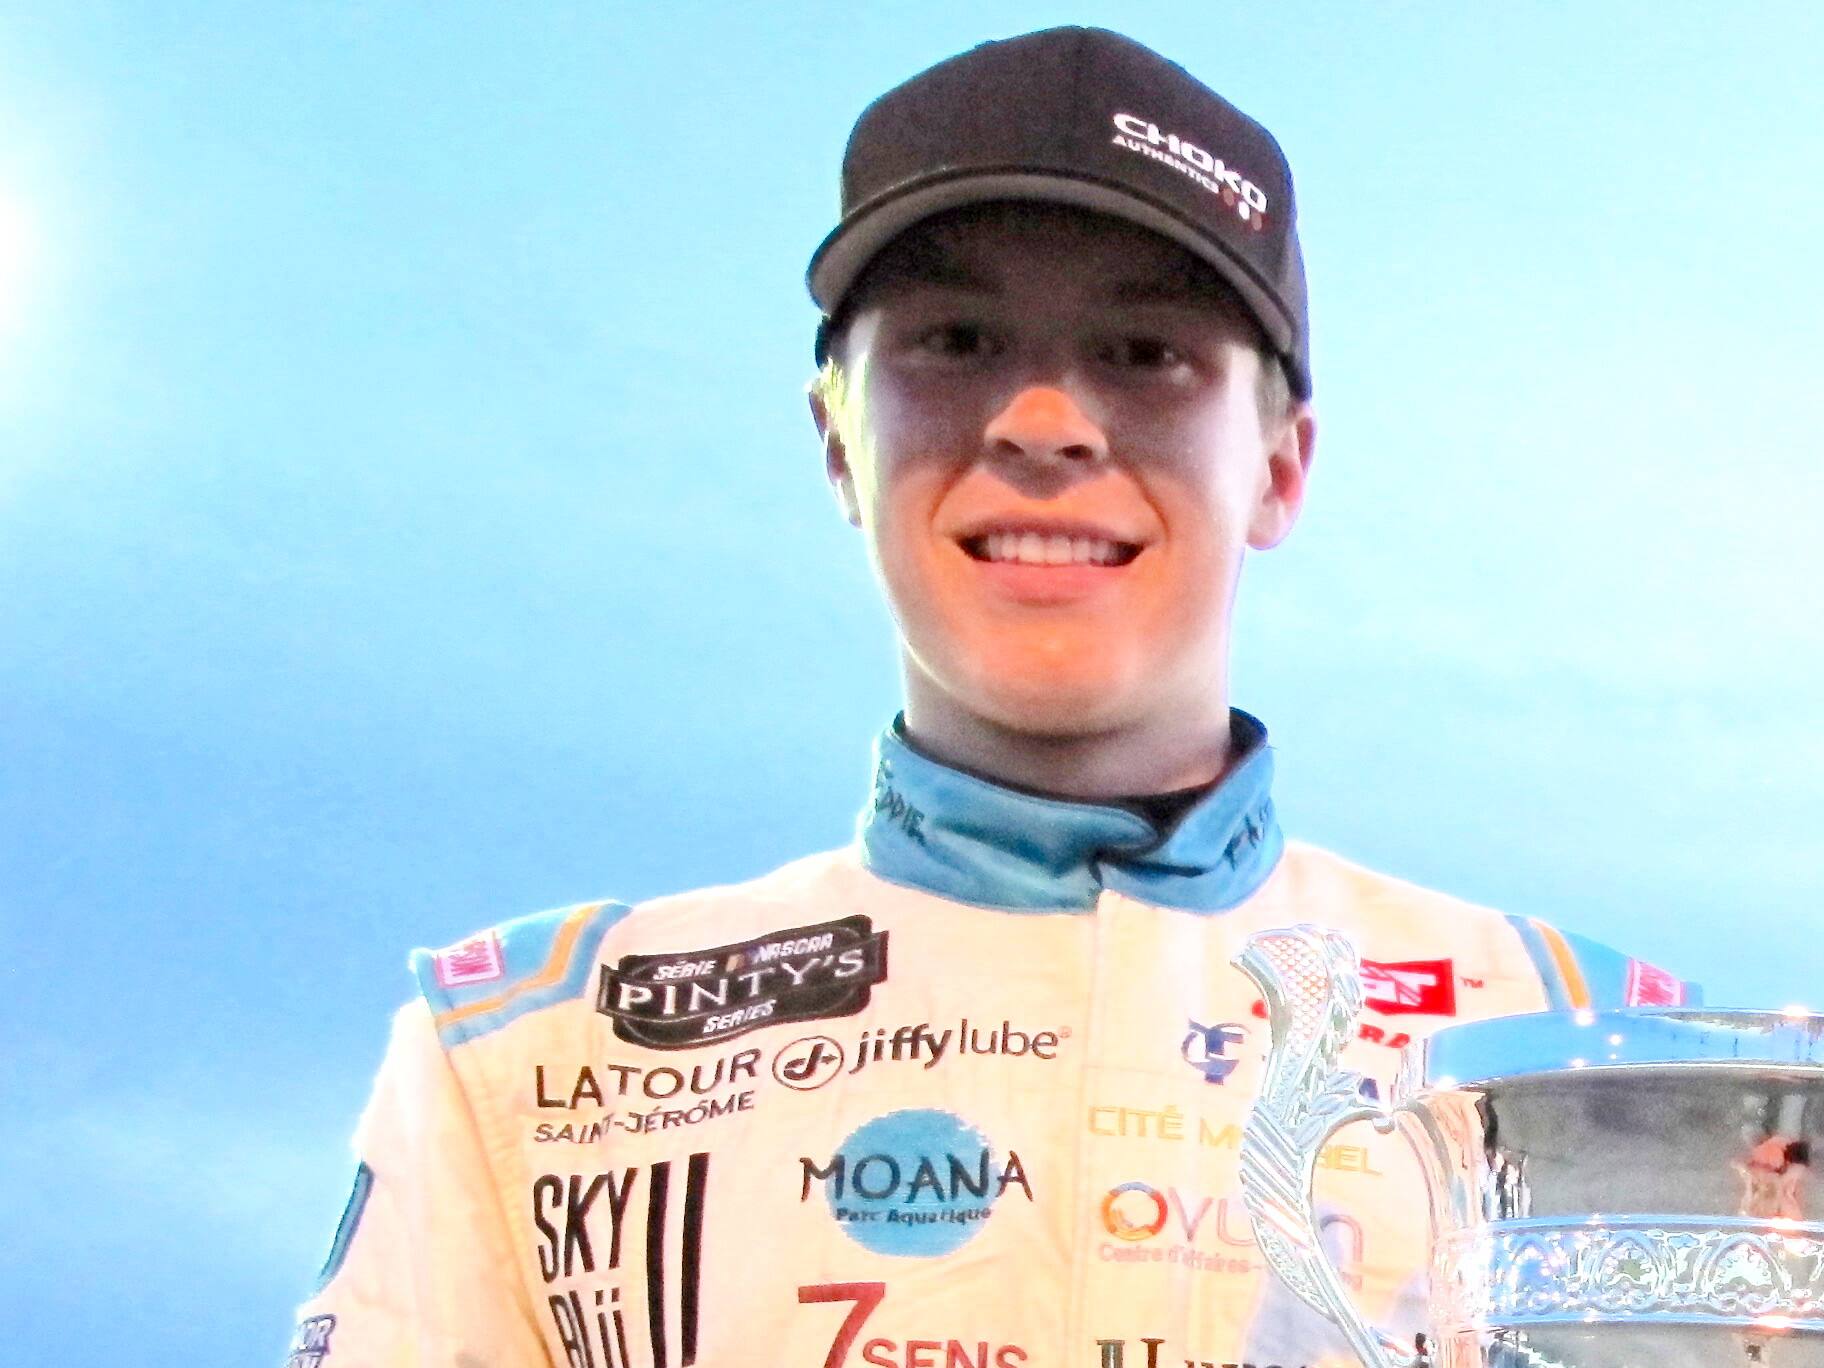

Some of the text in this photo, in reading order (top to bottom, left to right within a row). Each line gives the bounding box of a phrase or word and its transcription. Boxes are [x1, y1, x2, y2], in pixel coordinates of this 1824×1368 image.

[1112, 112, 1268, 214] CHOKO
[752, 931, 835, 961] NASCAR
[618, 946, 868, 1016] PINTY'S
[703, 1000, 776, 1035] SERIES
[534, 1048, 761, 1111] LATOUR
[533, 1090, 756, 1144] SAINT-JÉRÔME
[1087, 1104, 1185, 1141] CITÉ
[799, 1147, 1034, 1204] MOANA
[533, 1167, 638, 1284] SKY
